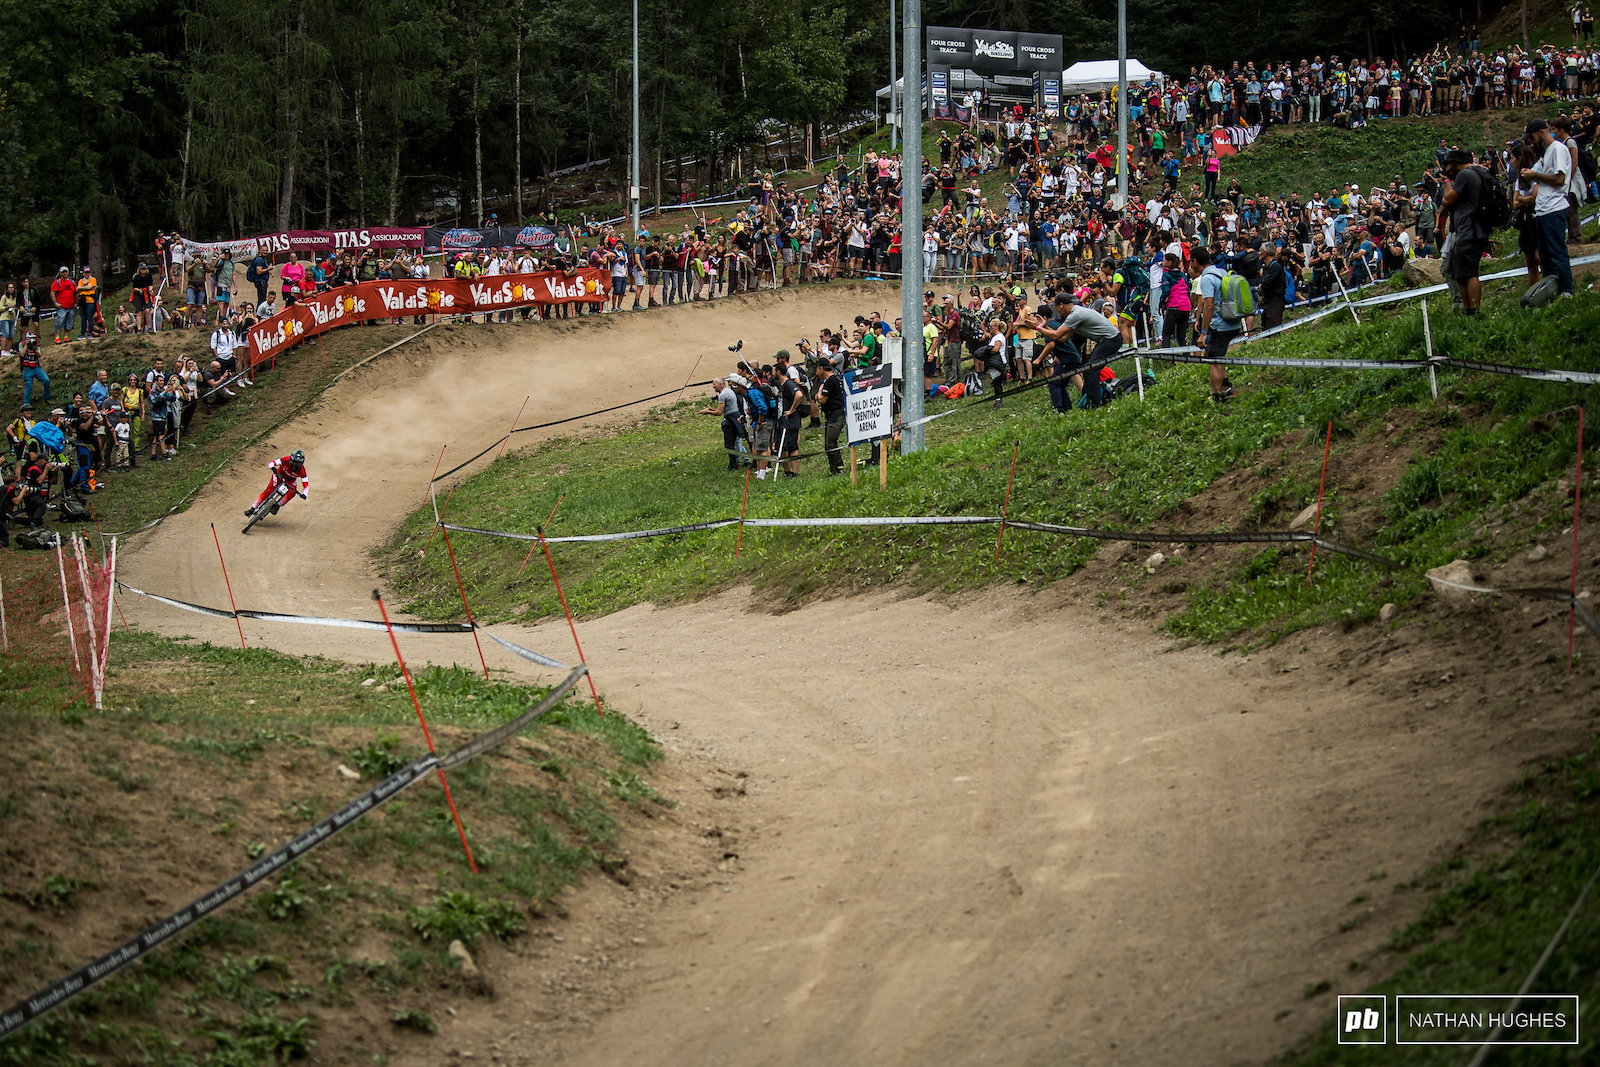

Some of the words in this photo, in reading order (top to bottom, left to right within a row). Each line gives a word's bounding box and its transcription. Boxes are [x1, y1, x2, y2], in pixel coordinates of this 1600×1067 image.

[975, 38, 989, 50] Val
[995, 41, 1014, 52] Sole
[333, 230, 371, 248] ITAS
[378, 286, 404, 310] Val
[405, 295, 417, 308] di
[416, 286, 455, 309] Sole
[469, 283, 492, 306] Val
[492, 292, 503, 304] di
[502, 281, 535, 304] Sole
[544, 277, 566, 300] Val
[566, 287, 577, 298] di
[309, 302, 329, 327] Val
[335, 294, 366, 319] Sole
[253, 329, 272, 354] Val
[277, 318, 304, 343] Sole
[852, 401, 862, 411] VAL
[862, 399, 869, 410] DI
[869, 395, 883, 408] SOLE
[855, 408, 880, 422] TRENTINO
[859, 420, 877, 432] ARENA
[143, 911, 192, 947] Mercedes-Benz
[87, 943, 140, 979] Mercedes-Benz
[28, 976, 84, 1013] Mercedes-Benz
